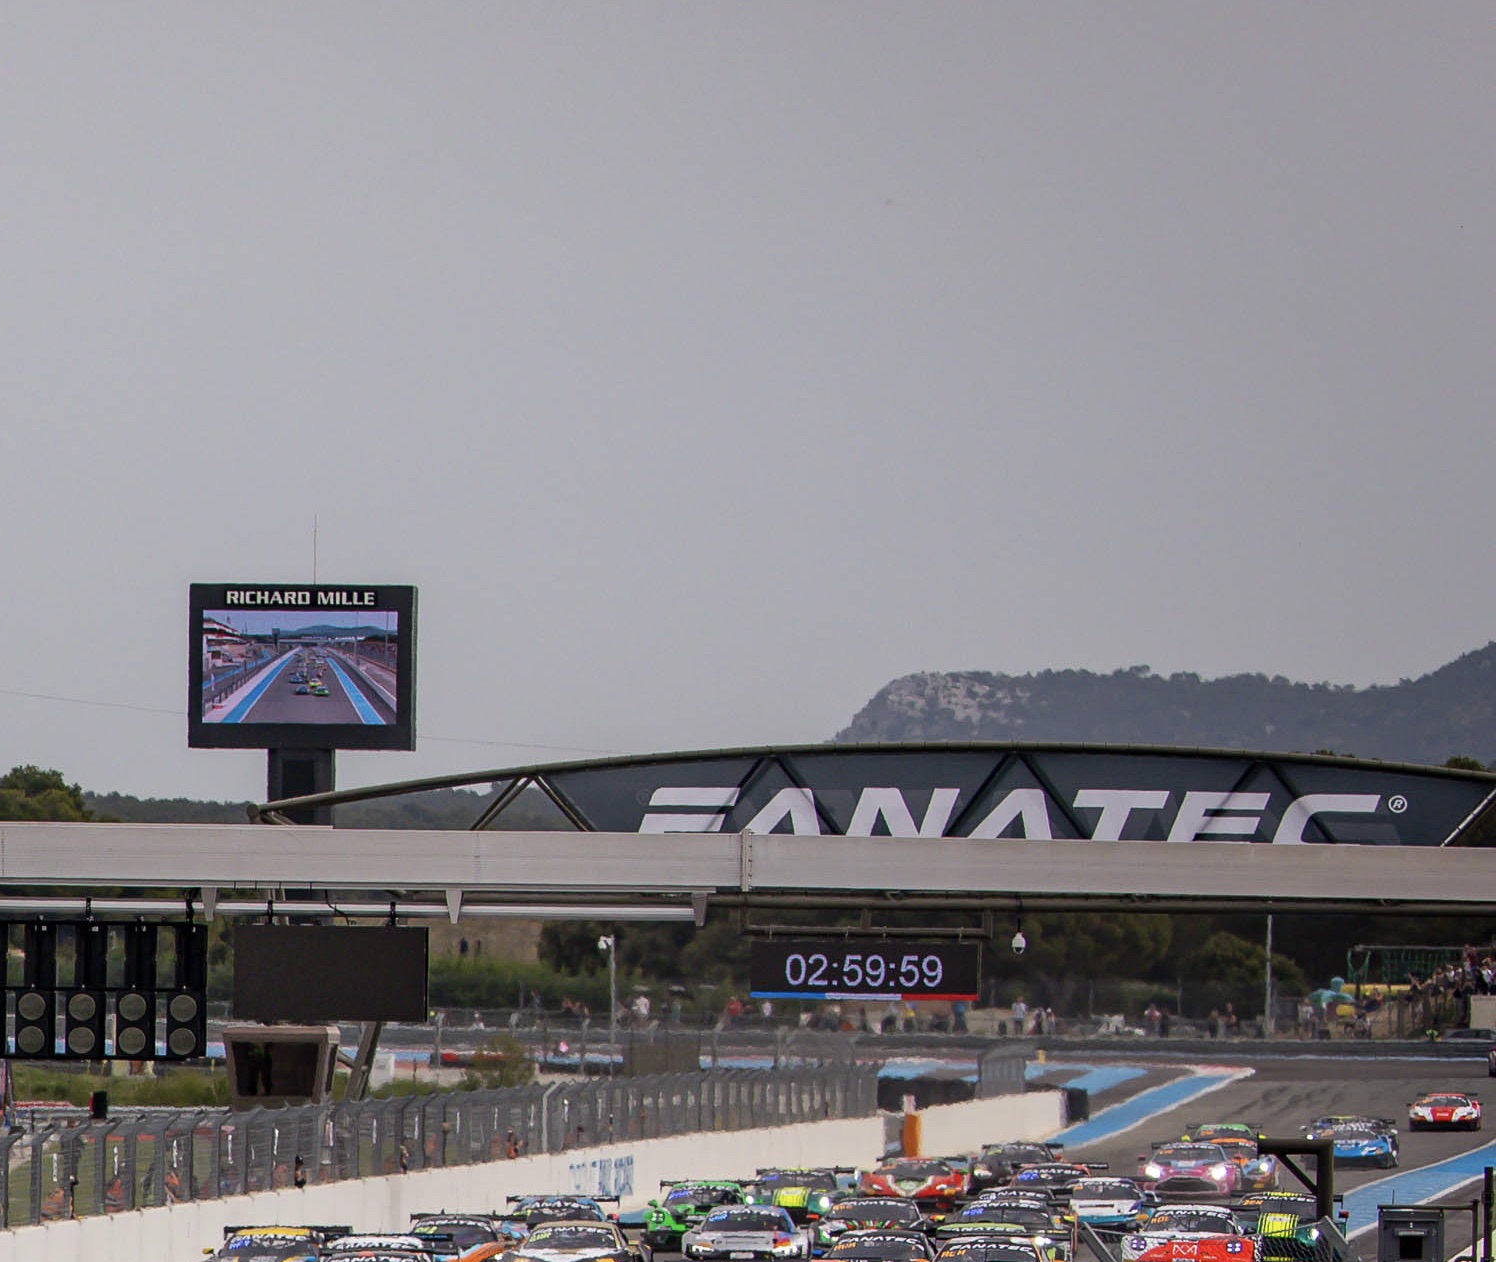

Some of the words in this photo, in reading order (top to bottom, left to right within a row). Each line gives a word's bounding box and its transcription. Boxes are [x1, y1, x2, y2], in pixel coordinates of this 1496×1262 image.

[226, 590, 310, 605] RICHARD
[317, 591, 375, 605] MILLE
[785, 953, 944, 989] 02:59:59
